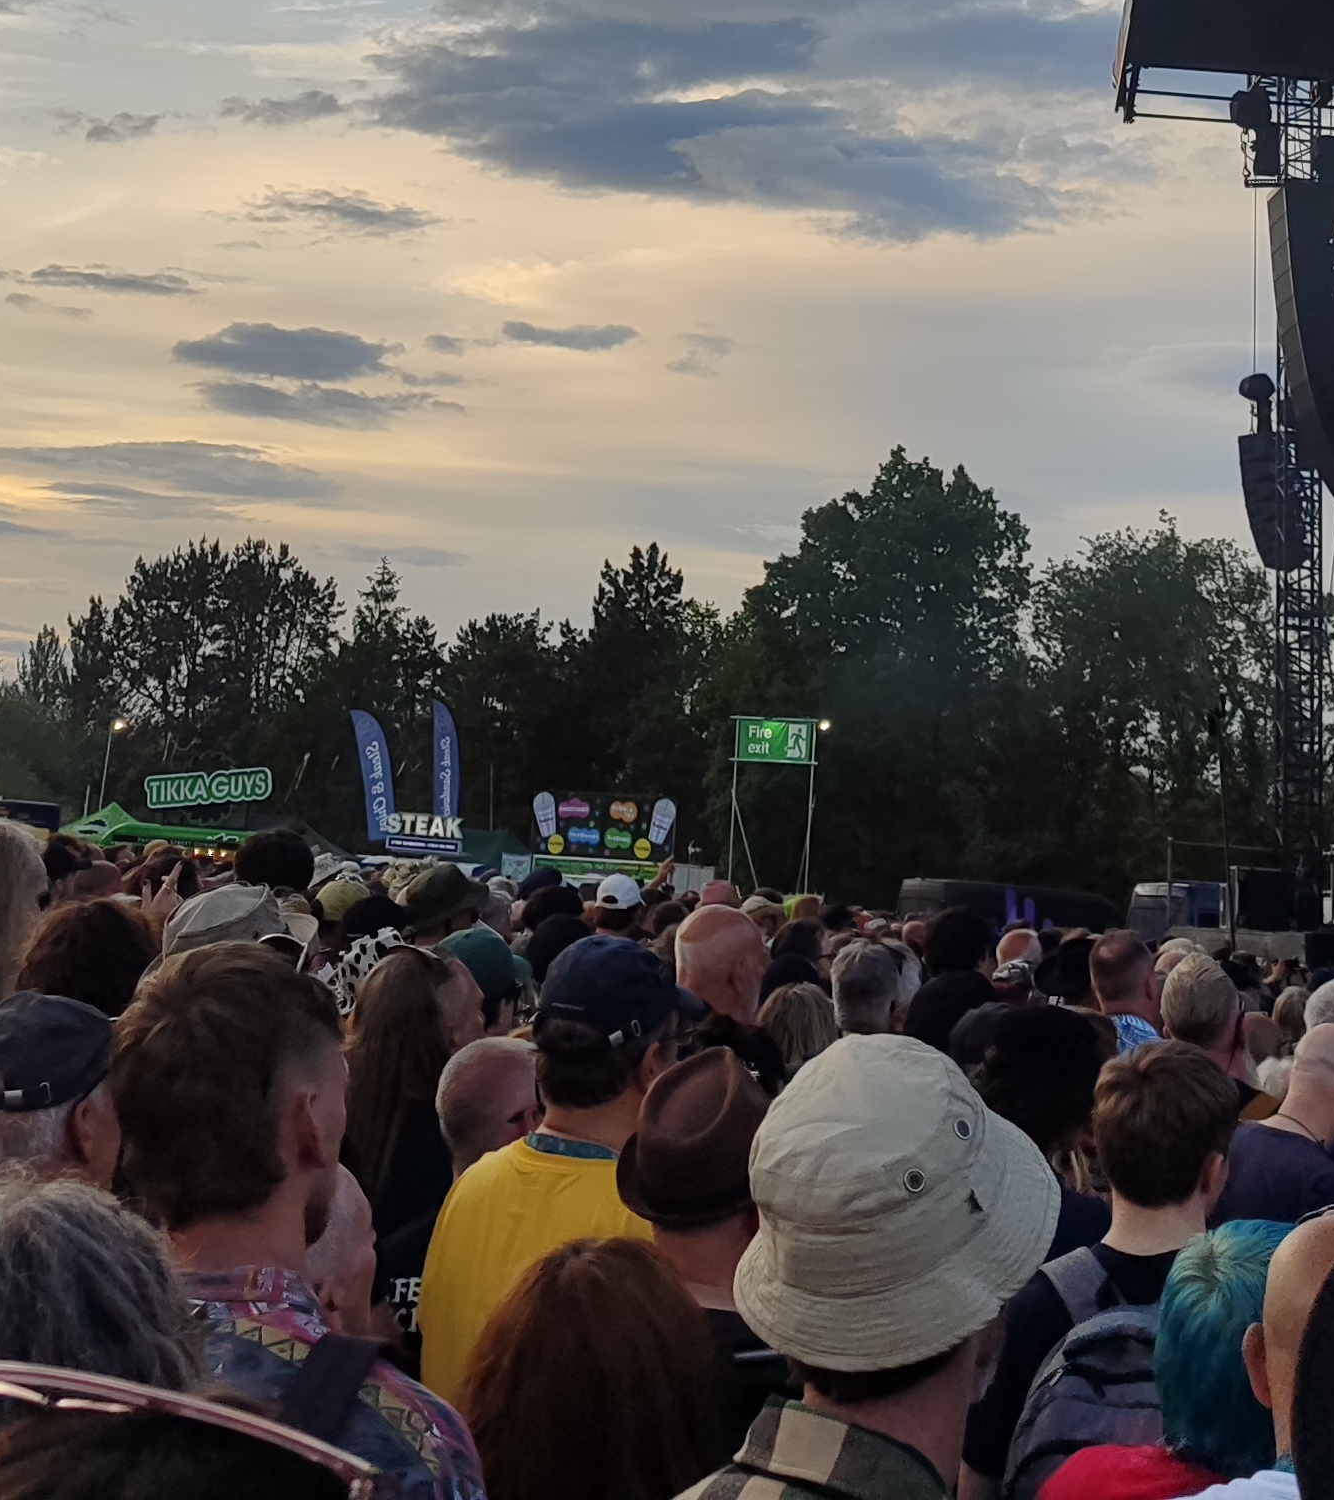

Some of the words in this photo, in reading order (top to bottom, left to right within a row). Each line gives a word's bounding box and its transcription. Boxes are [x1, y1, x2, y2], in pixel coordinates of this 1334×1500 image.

[748, 725, 772, 739] Fire
[748, 741, 770, 754] exit
[150, 778, 208, 803] TIKKA
[211, 773, 266, 798] GUYS
[387, 812, 463, 839] STEAK
